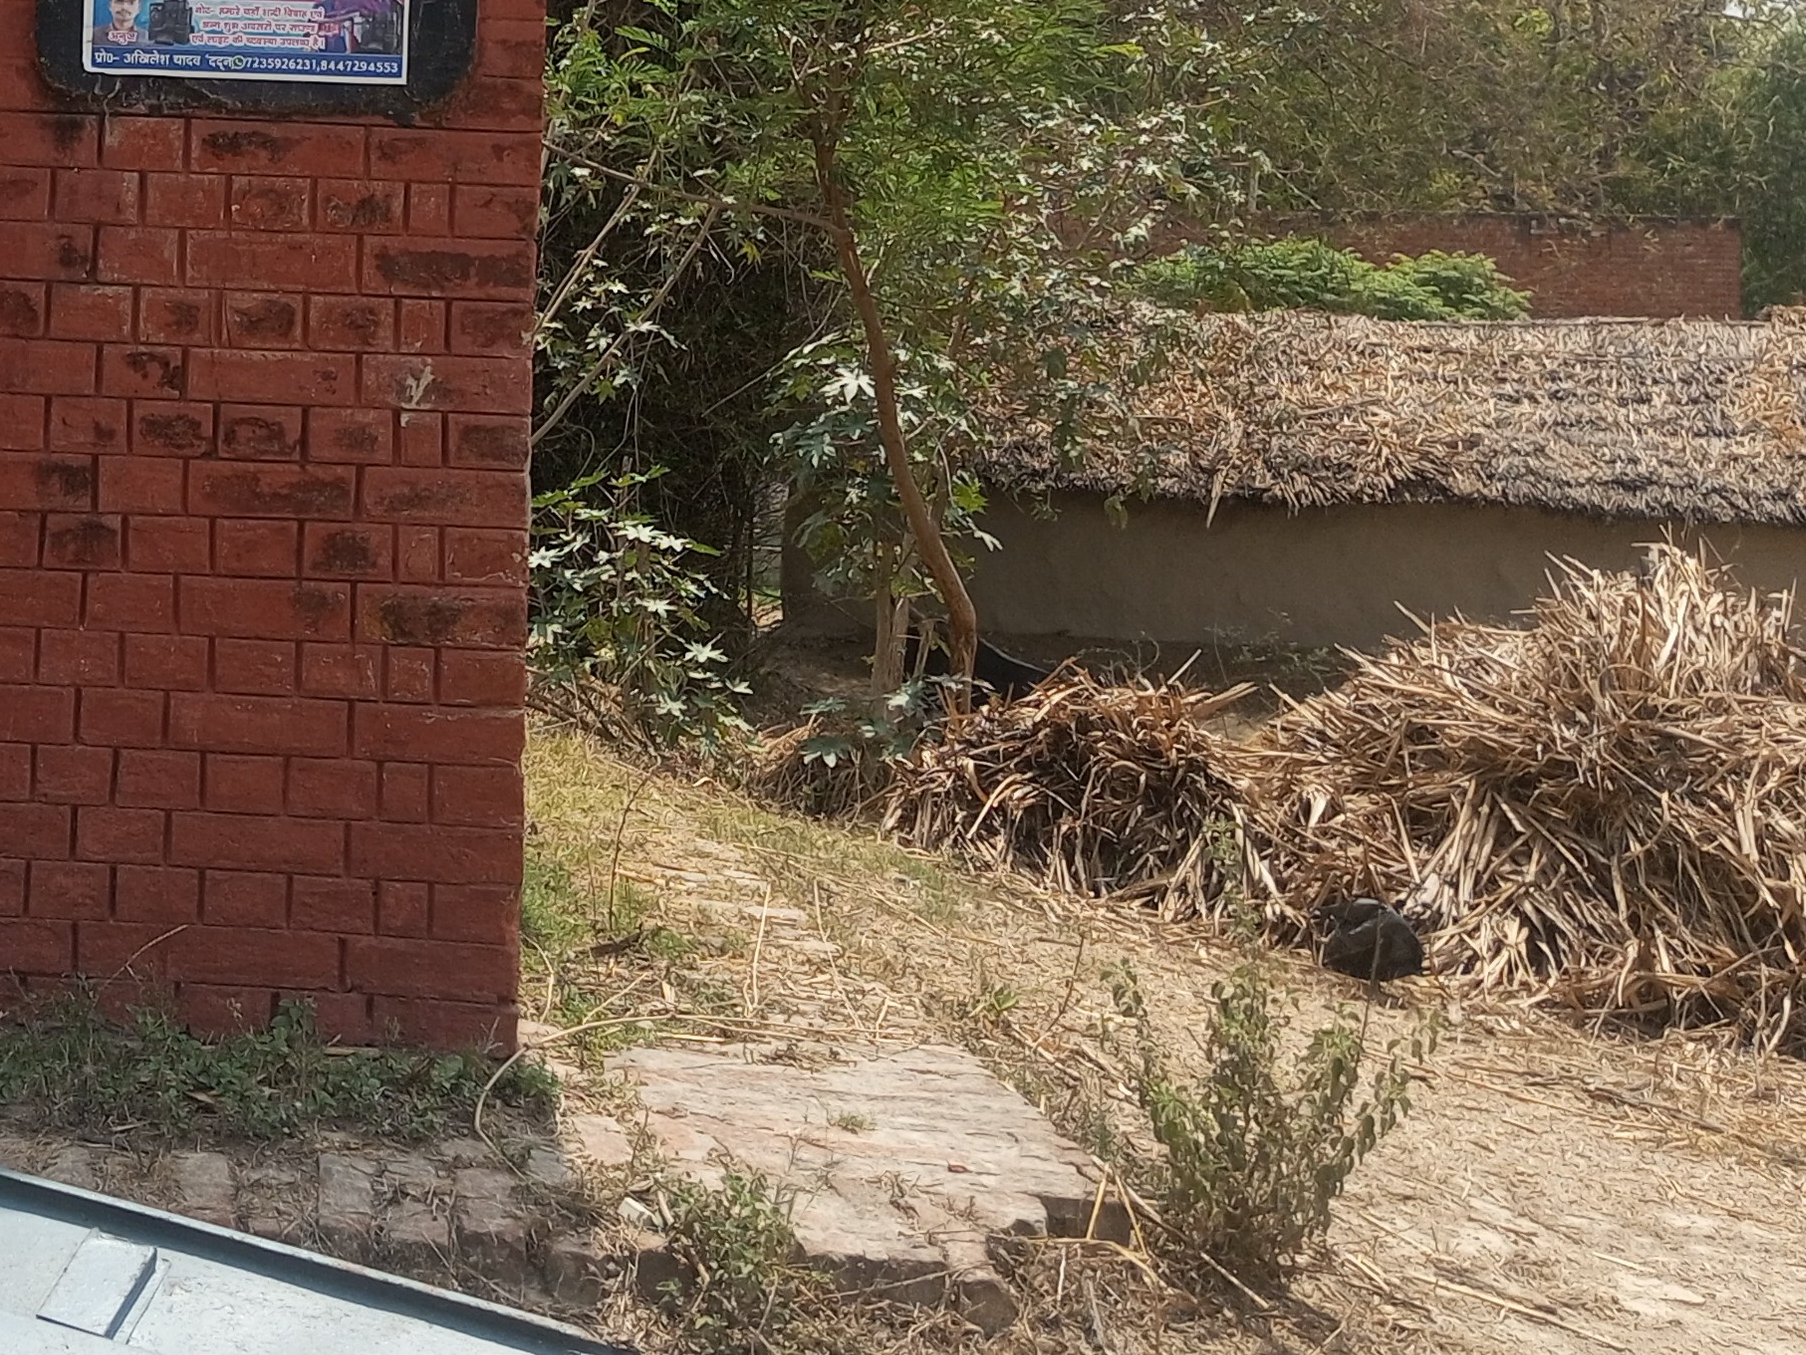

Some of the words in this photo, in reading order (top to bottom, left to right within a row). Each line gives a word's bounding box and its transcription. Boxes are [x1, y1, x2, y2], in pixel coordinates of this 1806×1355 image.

[284, 6, 307, 18] विवाह
[274, 23, 287, 32] पर
[123, 49, 170, 67] अखिलेश
[173, 54, 202, 66] यादव
